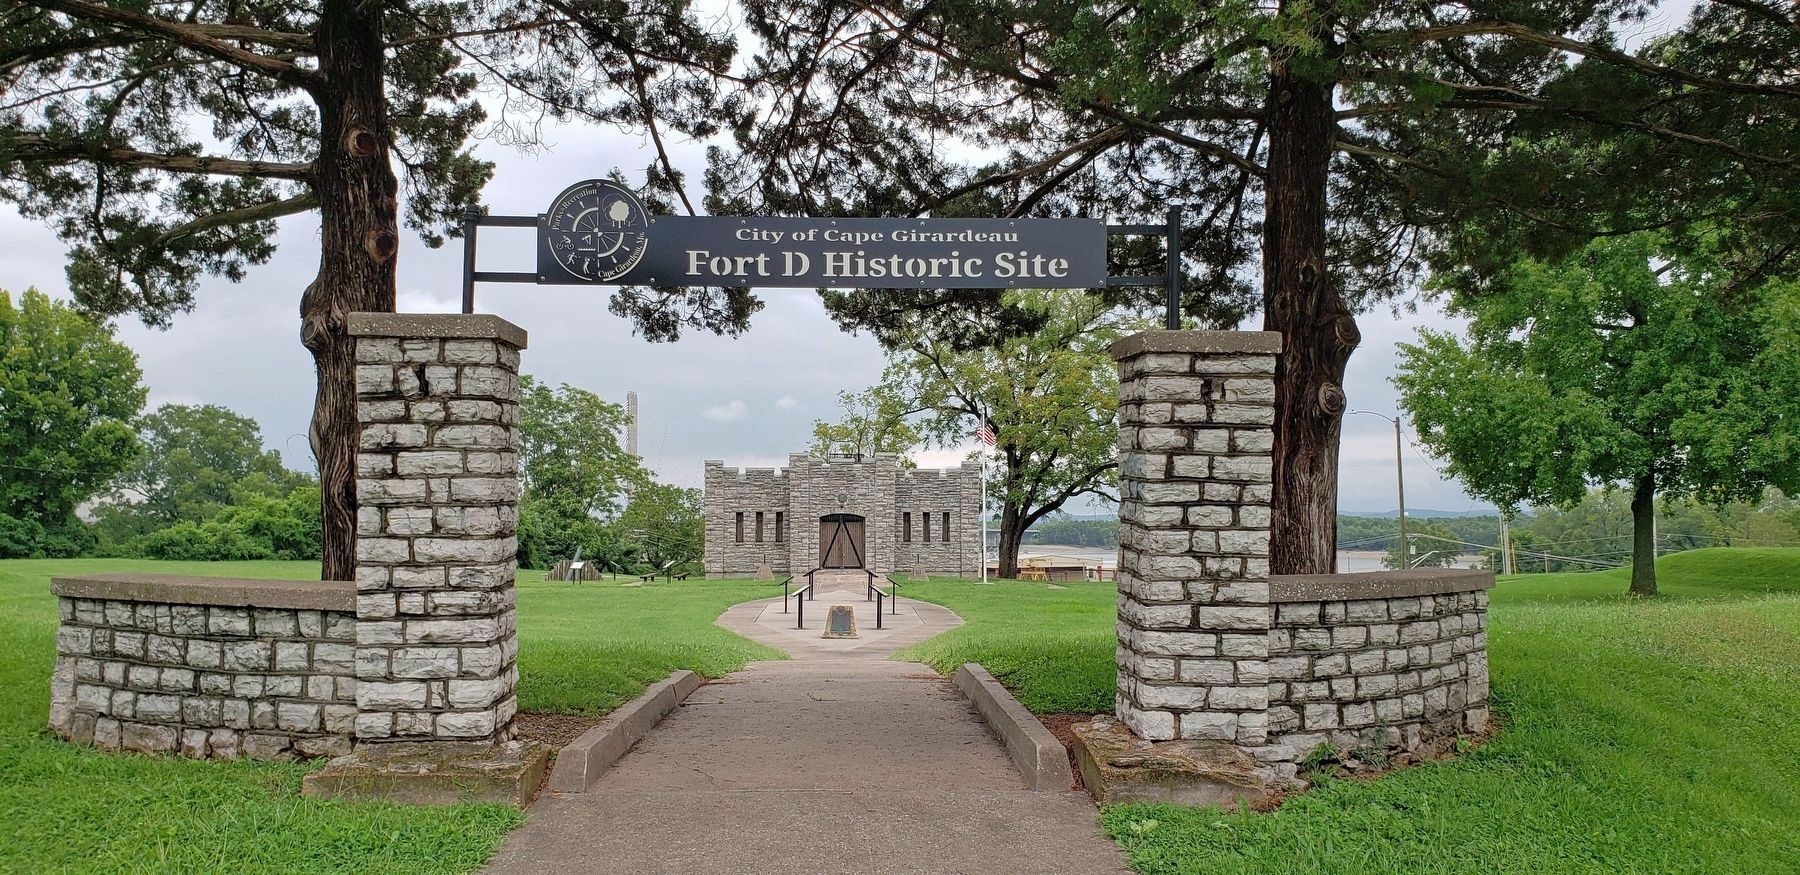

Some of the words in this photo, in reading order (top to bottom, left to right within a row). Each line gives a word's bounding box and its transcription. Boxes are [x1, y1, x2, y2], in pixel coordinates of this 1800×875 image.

[552, 211, 563, 230] Parks
[735, 228, 785, 245] City
[791, 228, 819, 242] of
[823, 229, 884, 245] Cape
[890, 229, 1019, 242] Girardeau
[686, 251, 771, 277] Fort
[782, 251, 811, 277] D
[822, 250, 984, 278] Historic
[994, 251, 1069, 278] Site
[598, 269, 616, 278] Cape
